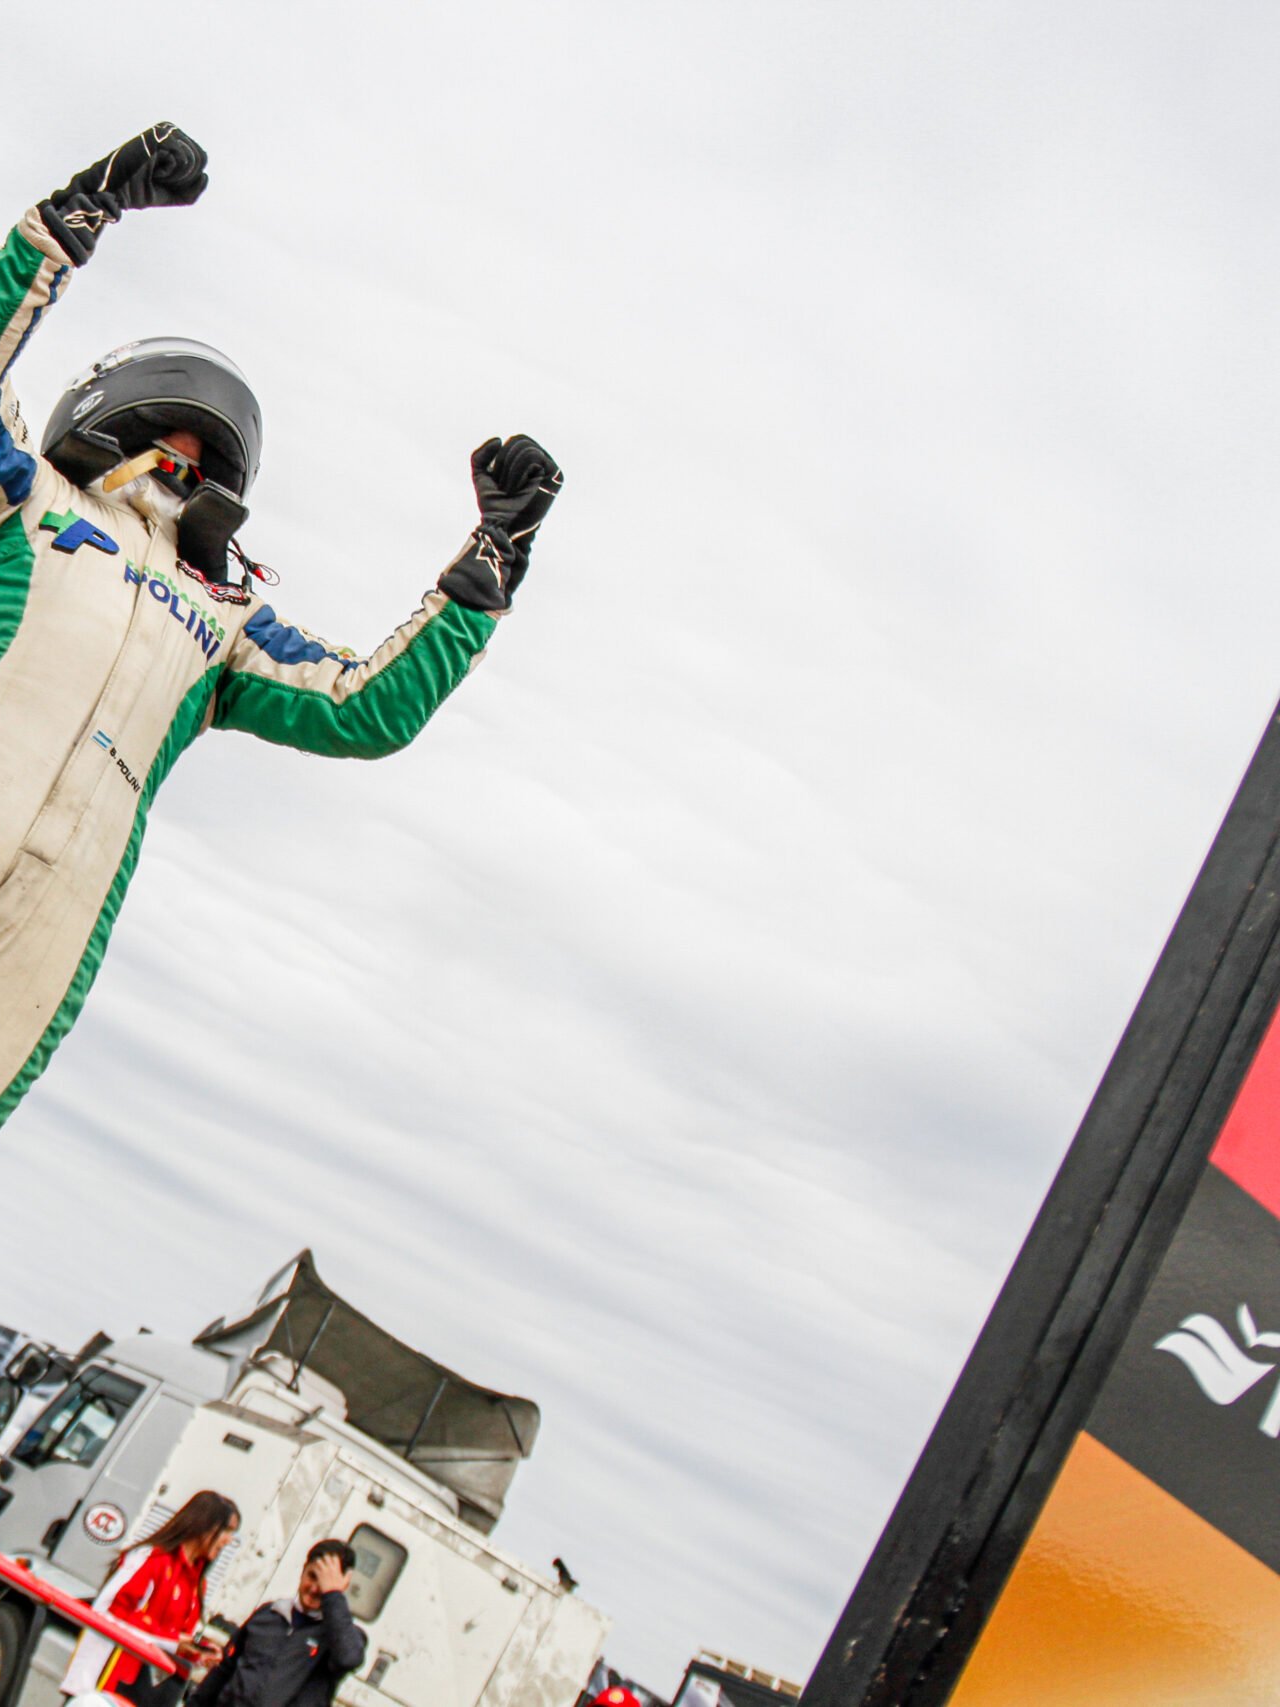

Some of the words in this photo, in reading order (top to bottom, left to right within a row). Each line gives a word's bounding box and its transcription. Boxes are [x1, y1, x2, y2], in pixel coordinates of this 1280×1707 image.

[124, 564, 220, 661] POLINI
[125, 557, 225, 640] FARMACIAS
[116, 757, 141, 794] POLINI
